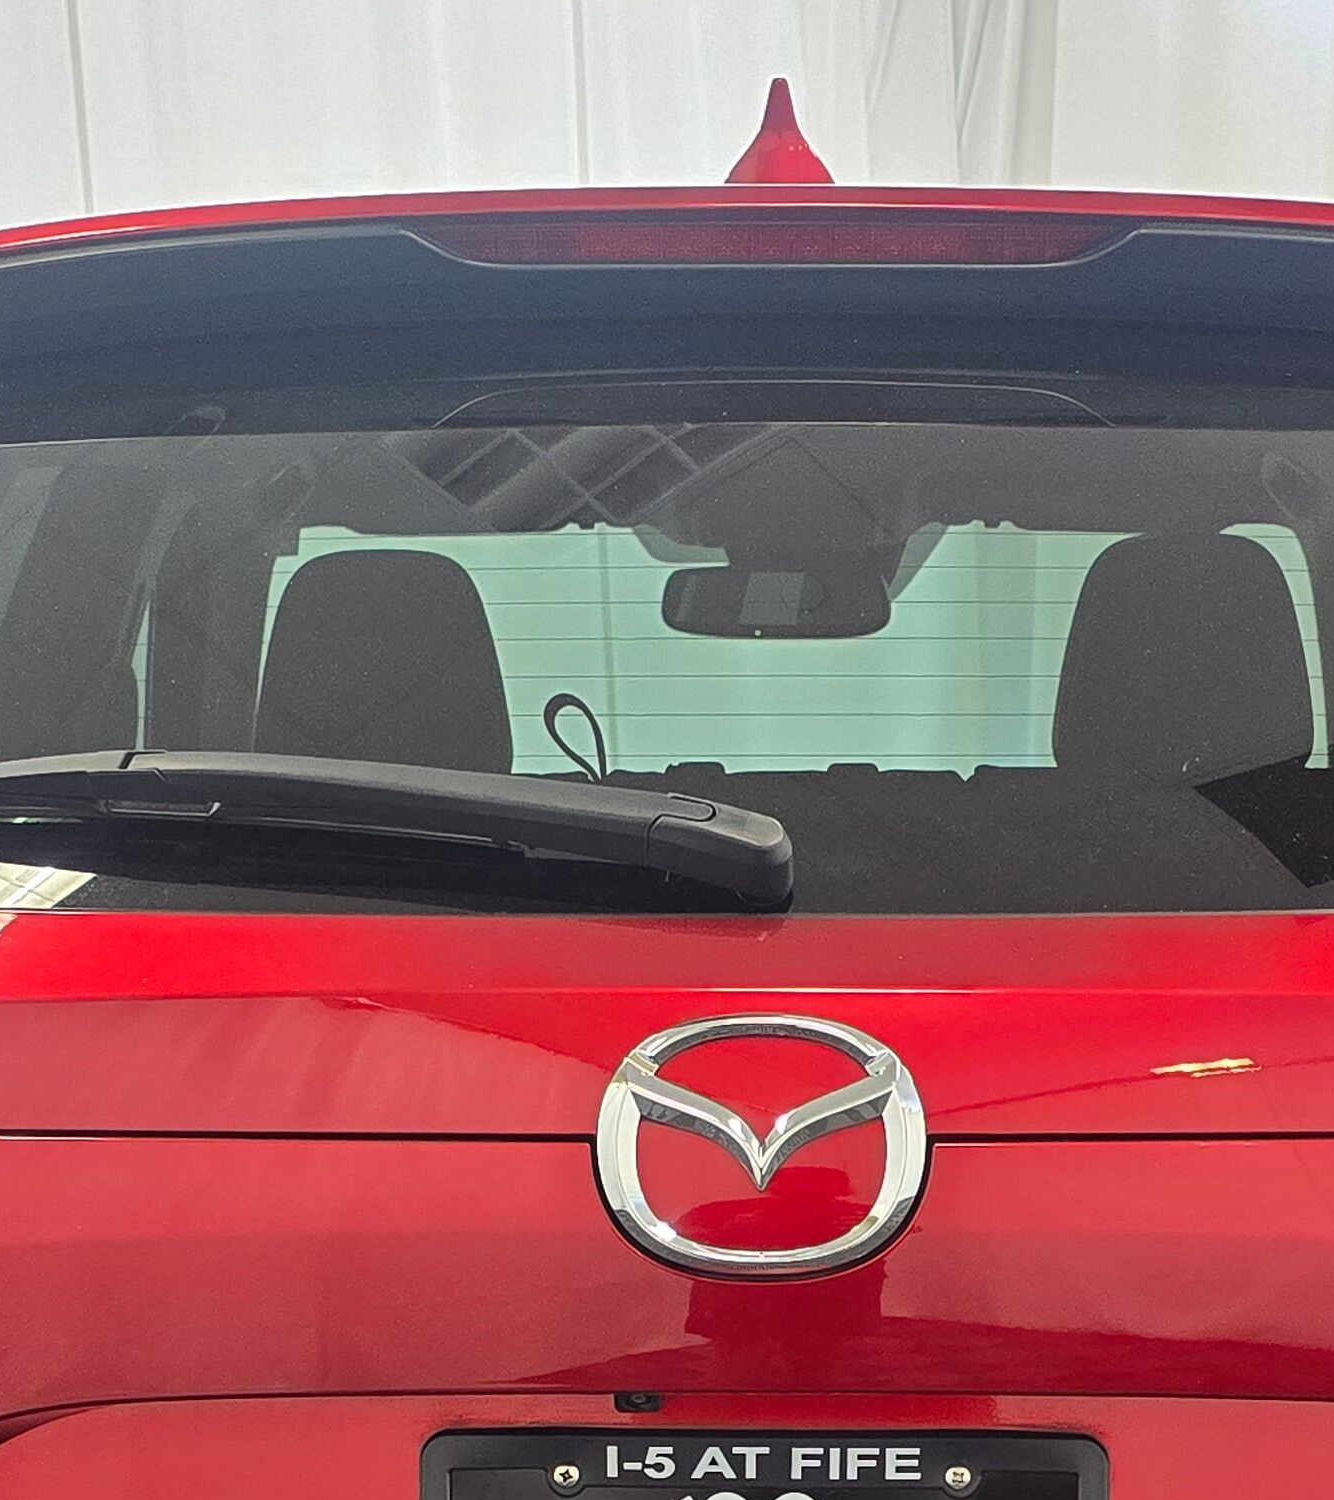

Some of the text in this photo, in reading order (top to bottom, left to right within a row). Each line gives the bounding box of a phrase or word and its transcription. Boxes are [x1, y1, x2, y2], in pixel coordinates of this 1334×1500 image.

[607, 1446, 923, 1480] I-5 AT FIFE
